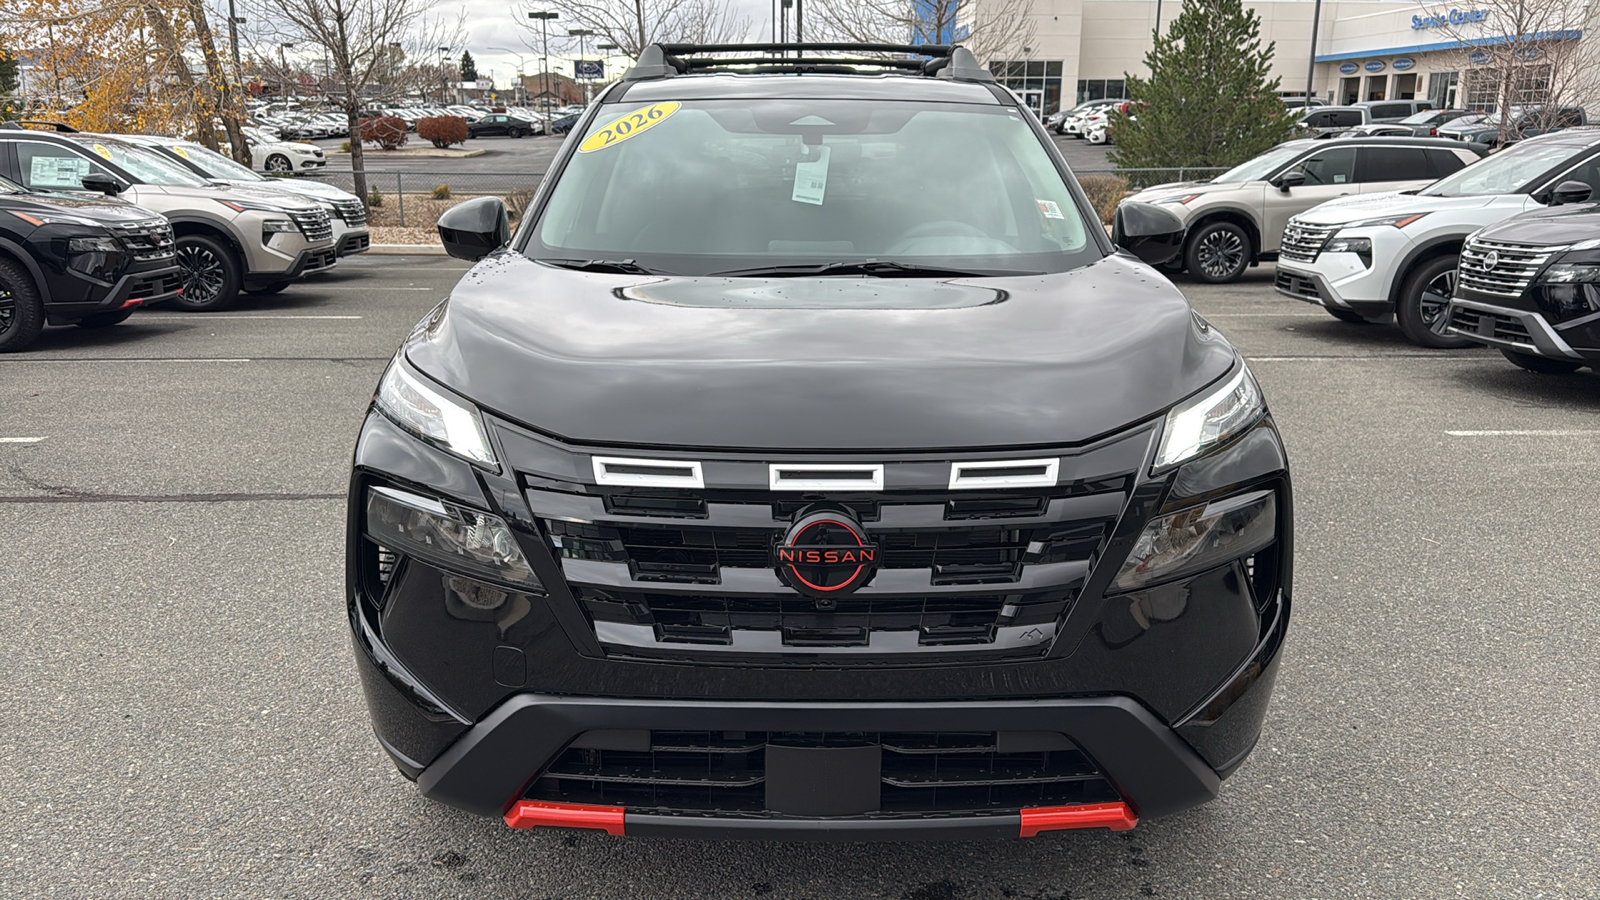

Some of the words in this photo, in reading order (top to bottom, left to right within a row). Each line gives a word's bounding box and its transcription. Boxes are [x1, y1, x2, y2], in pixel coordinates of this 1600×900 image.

[1449, 8, 1487, 25] Center
[598, 105, 663, 145] 2026
[779, 549, 874, 563] NISSAN
